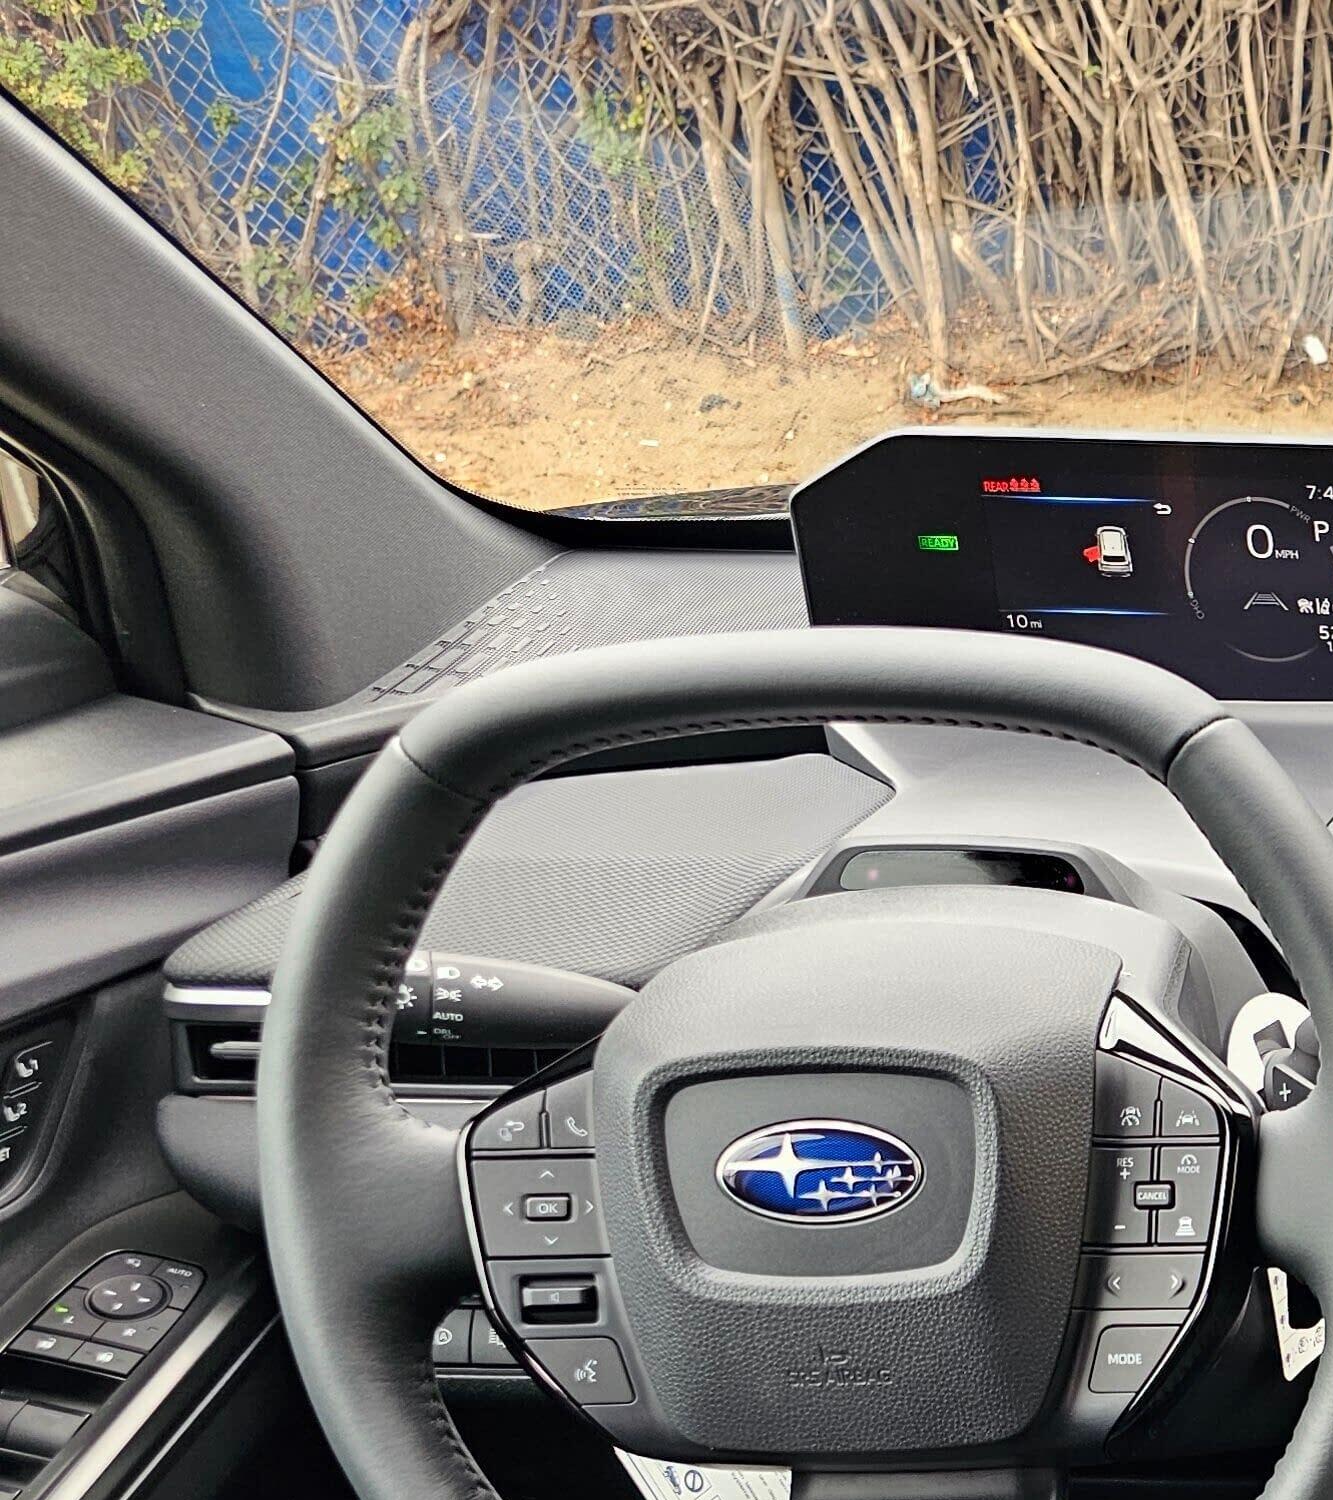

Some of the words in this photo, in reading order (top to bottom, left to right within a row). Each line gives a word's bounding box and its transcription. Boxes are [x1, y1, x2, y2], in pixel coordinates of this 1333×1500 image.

[983, 480, 1008, 493] REAR
[1290, 505, 1311, 524] PWR
[1313, 520, 1330, 542] P
[920, 537, 957, 549] READY
[1246, 524, 1275, 559] 0
[1275, 549, 1300, 560] MPH
[432, 1011, 464, 1022] AUTO
[1117, 1157, 1134, 1168] RES
[1177, 1166, 1200, 1174] MODE
[1137, 1191, 1168, 1201] CANCEL
[538, 1202, 558, 1214] OK
[167, 1267, 193, 1278] AUTO
[1107, 1354, 1143, 1365] MODE
